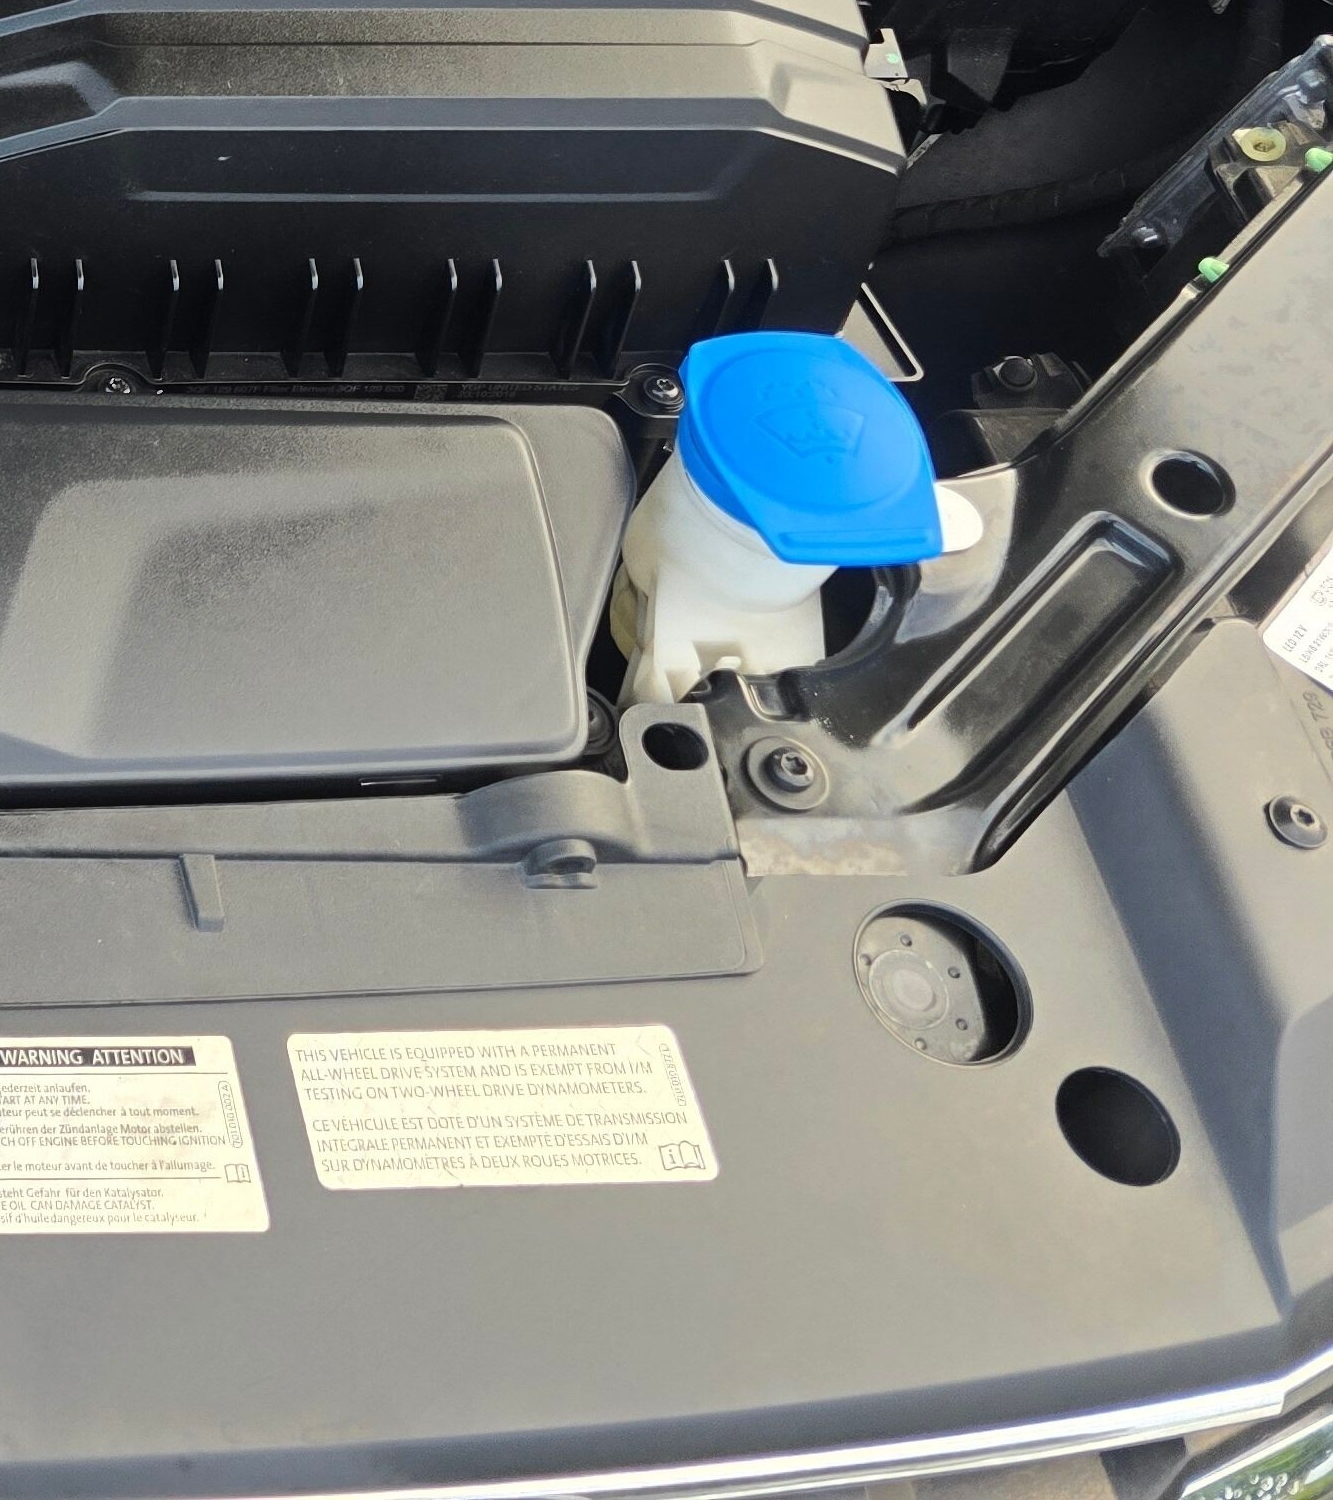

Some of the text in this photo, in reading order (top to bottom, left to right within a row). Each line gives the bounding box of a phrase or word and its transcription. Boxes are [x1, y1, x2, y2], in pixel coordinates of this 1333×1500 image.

[91, 1048, 185, 1066] ATTENTION
[293, 1042, 616, 1063] THIS VEHICLE IS EQUIPPED WITH A PERMANENT
[300, 1066, 379, 1083] ALL-WHEEL
[379, 1065, 423, 1081] DRIVE
[423, 1064, 478, 1079] SYSTEM
[479, 1063, 512, 1078] AND
[513, 1063, 528, 1077] IS
[529, 1062, 584, 1077] EXEMPT
[585, 1061, 628, 1077] FROM
[43, 1081, 92, 1097] anlaufen.
[303, 1080, 647, 1101] TESTING ON TWO-WHEEL DRIVE DYNAMOMETERS.
[23, 1094, 36, 1106] AT
[37, 1094, 60, 1106] ANY
[60, 1094, 91, 1106] TIME.
[16, 1135, 37, 1147] OFF
[38, 1135, 79, 1148] ENGINE
[79, 1133, 120, 1147] BEFORE
[119, 1134, 178, 1147] TOUCHING
[177, 1134, 227, 1147] IGNITION
[8, 1199, 27, 1212] OIL
[29, 1199, 54, 1212] CAN
[54, 1199, 103, 1212] DAMAGE
[103, 1197, 155, 1211] CATALYST.
